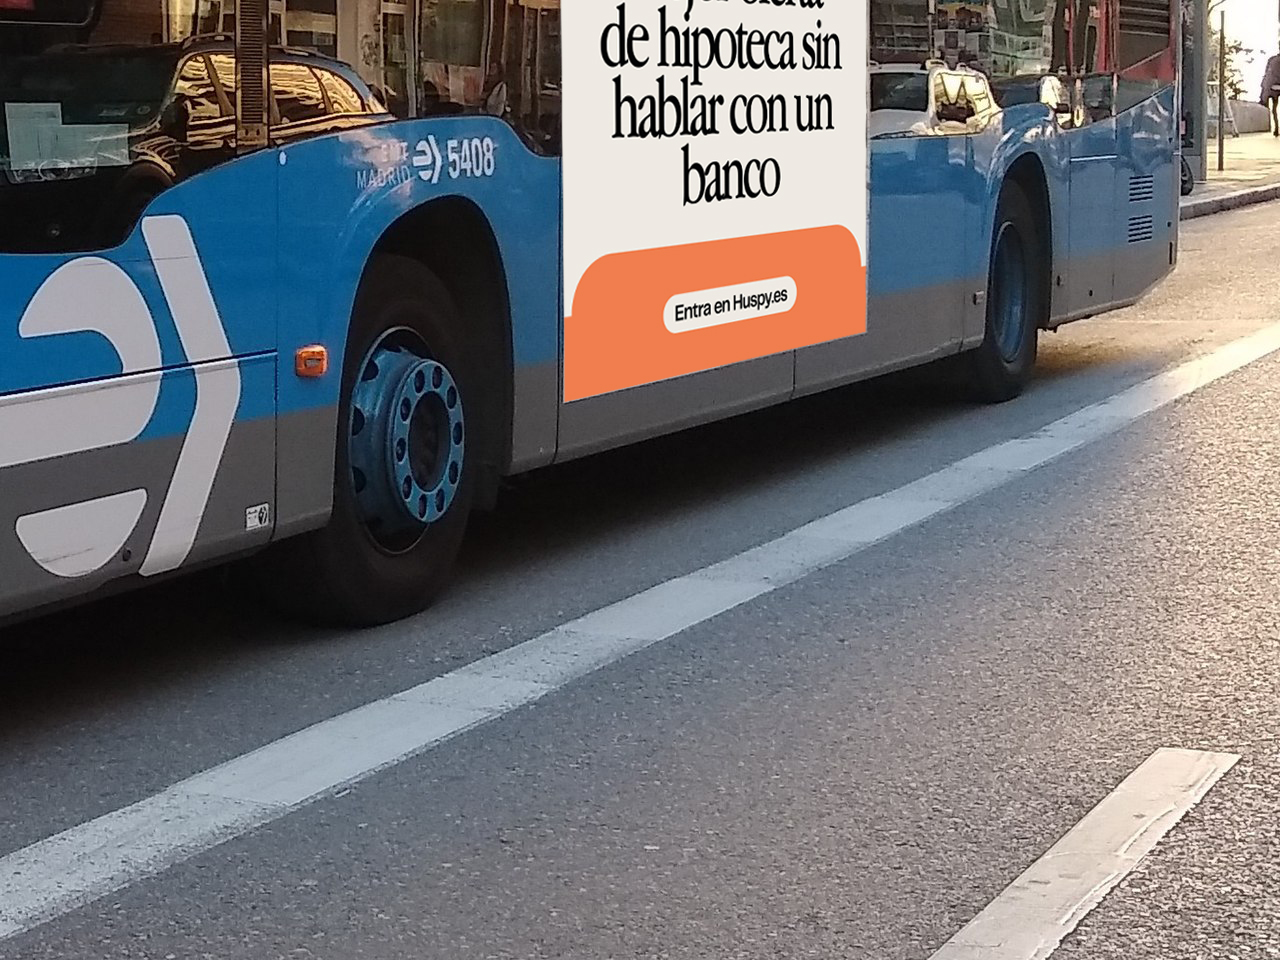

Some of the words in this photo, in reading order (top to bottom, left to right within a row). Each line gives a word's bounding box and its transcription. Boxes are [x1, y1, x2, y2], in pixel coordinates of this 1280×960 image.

[600, 2, 650, 68] de
[657, 5, 797, 86] hipoteca
[802, 19, 843, 70] sin
[612, 74, 725, 140] hablar
[730, 94, 789, 134] con
[793, 93, 835, 132] un
[356, 165, 412, 189] MADRID
[447, 136, 496, 179] 5408
[681, 143, 781, 206] banco
[675, 304, 712, 321] Entra
[714, 299, 731, 314] en
[733, 289, 788, 311] Huspy.es
